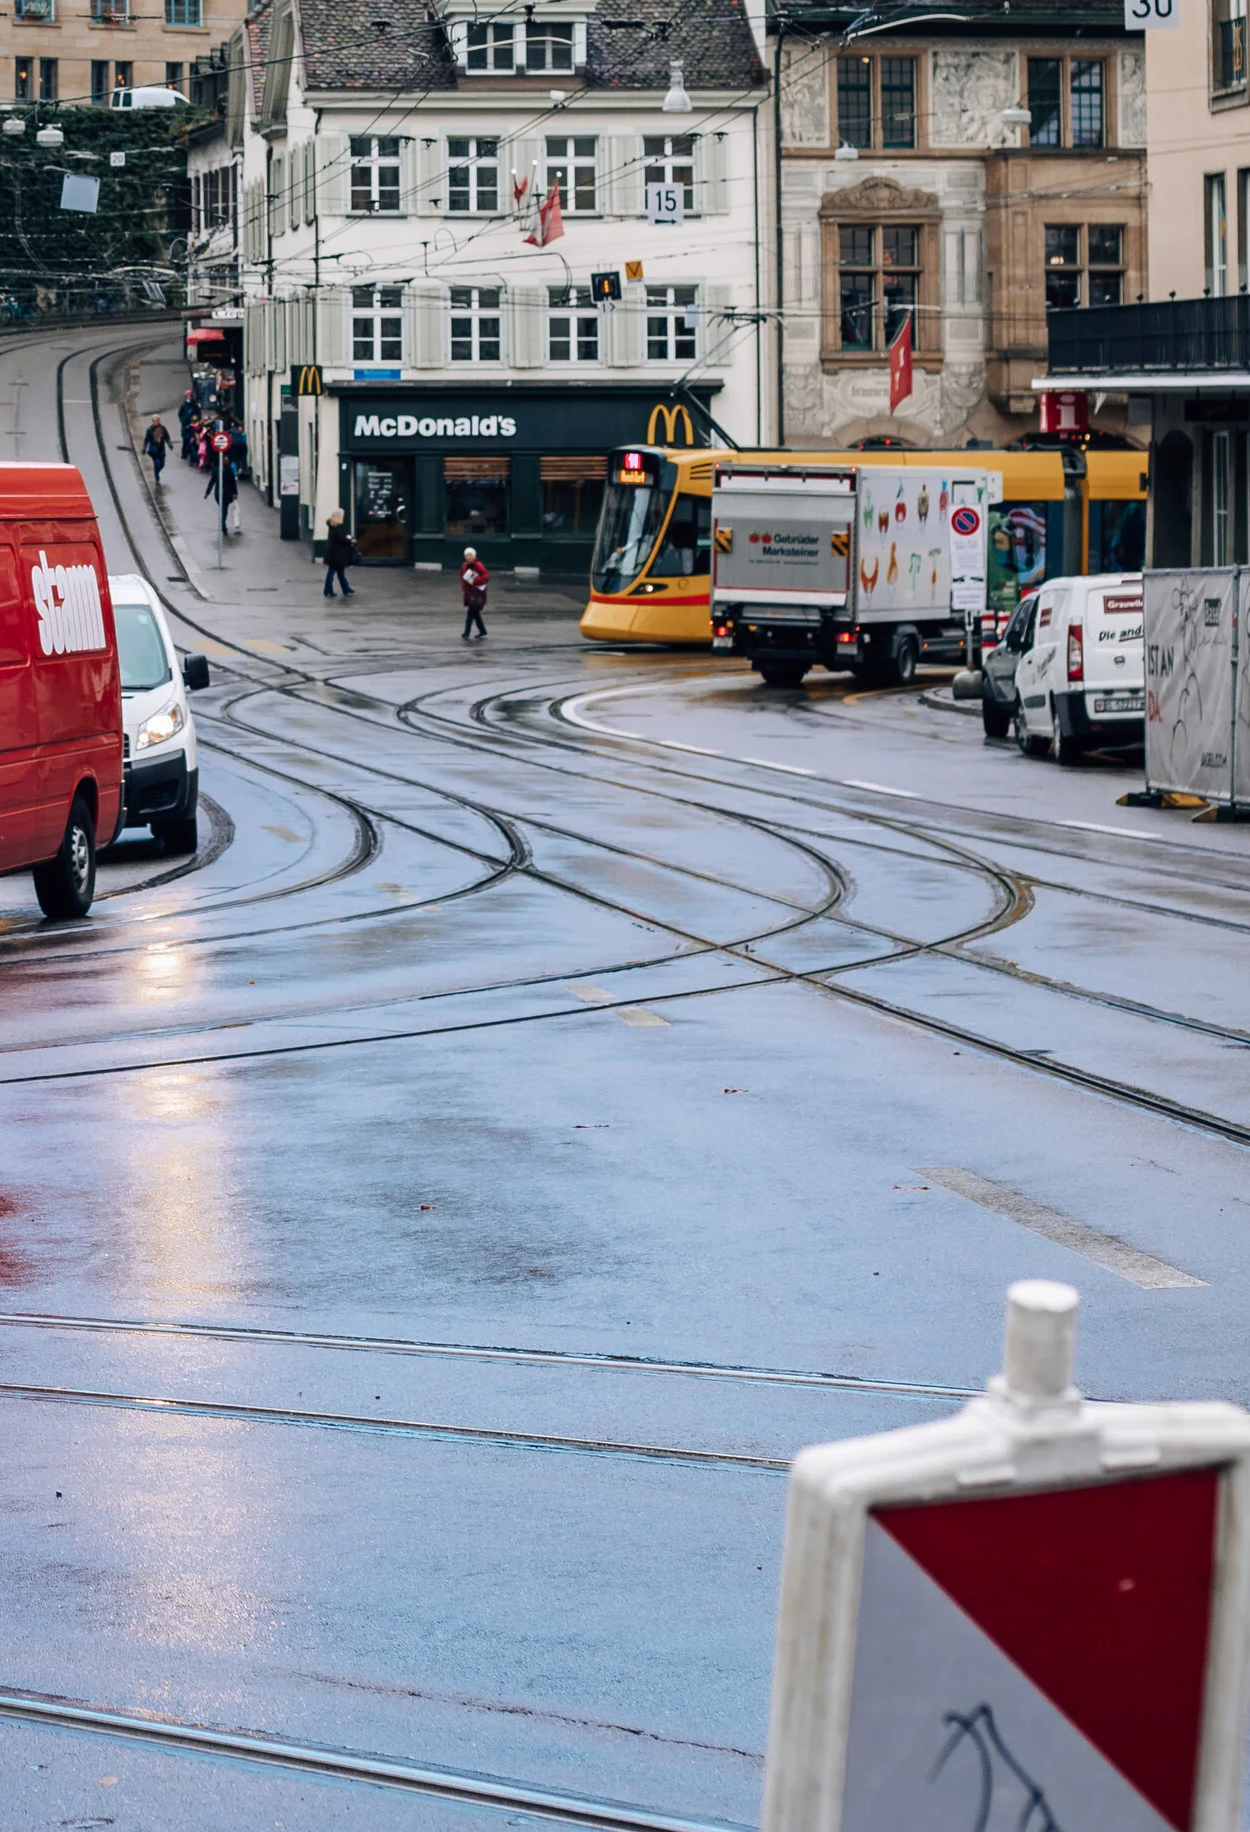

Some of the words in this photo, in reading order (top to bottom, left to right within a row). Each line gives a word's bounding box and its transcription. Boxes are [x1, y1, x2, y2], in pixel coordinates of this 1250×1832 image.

[656, 190, 677, 212] 15
[354, 415, 517, 437] McDonald's
[773, 533, 819, 545] Gebrüder
[762, 546, 819, 558] Marksteiner
[31, 550, 106, 656] stamm
[1099, 630, 1116, 642] Die
[1120, 625, 1145, 638] and
